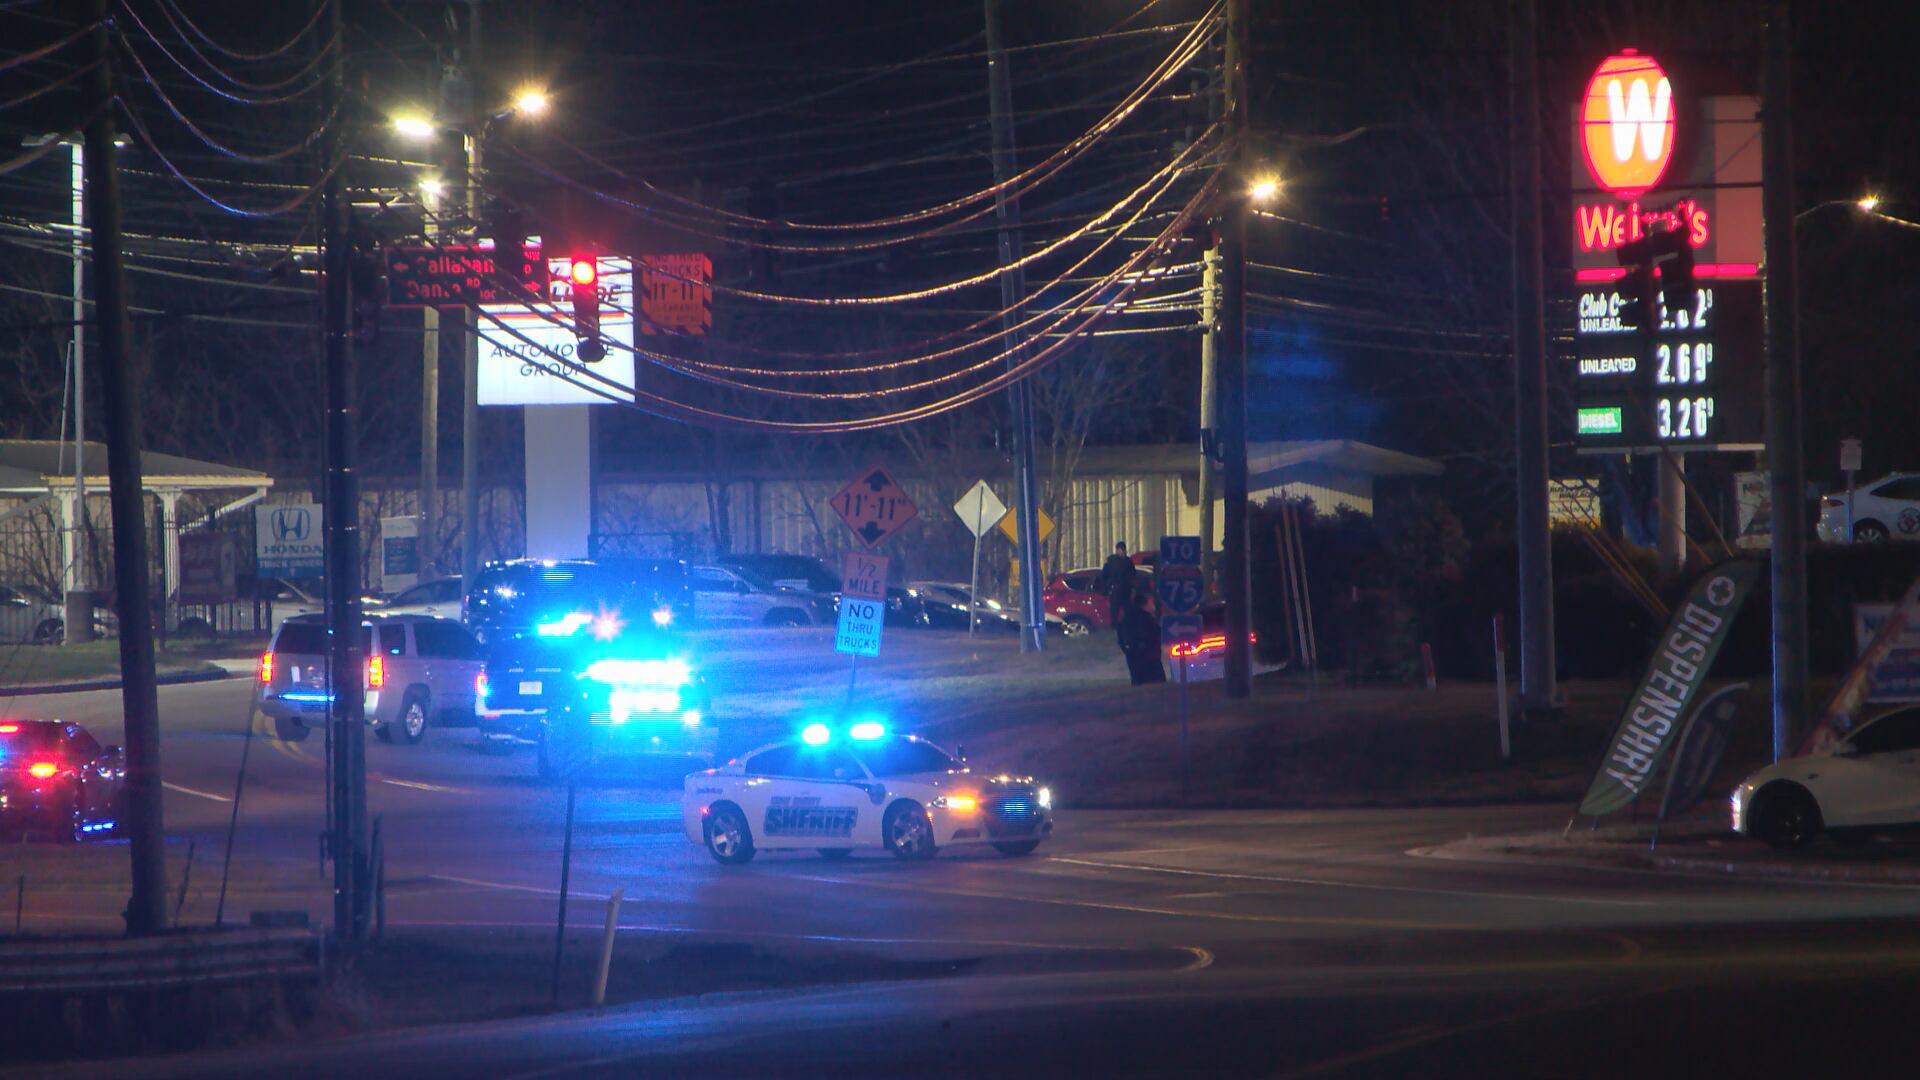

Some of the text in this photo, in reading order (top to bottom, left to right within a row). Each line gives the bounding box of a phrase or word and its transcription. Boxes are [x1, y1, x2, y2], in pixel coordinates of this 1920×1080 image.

[1608, 77, 1671, 161] W
[1578, 201, 1706, 249] Wei's
[466, 278, 480, 288] RD
[1580, 292, 1608, 317] Club
[1580, 317, 1637, 332] UNLEA
[491, 344, 614, 358] AUTOMOE
[520, 363, 586, 377] GROUP
[1581, 358, 1637, 374] UNLEADED
[1580, 413, 1618, 429] DIESEL
[264, 543, 323, 555] HONDA
[1168, 542, 1193, 560] TO
[857, 557, 877, 578] 1/2
[850, 578, 880, 596] MILE
[1166, 580, 1198, 604] 75
[849, 603, 875, 620] NO
[846, 620, 873, 635] THRU
[838, 635, 877, 650] TRUCKS
[766, 807, 857, 837] SHERIFF
